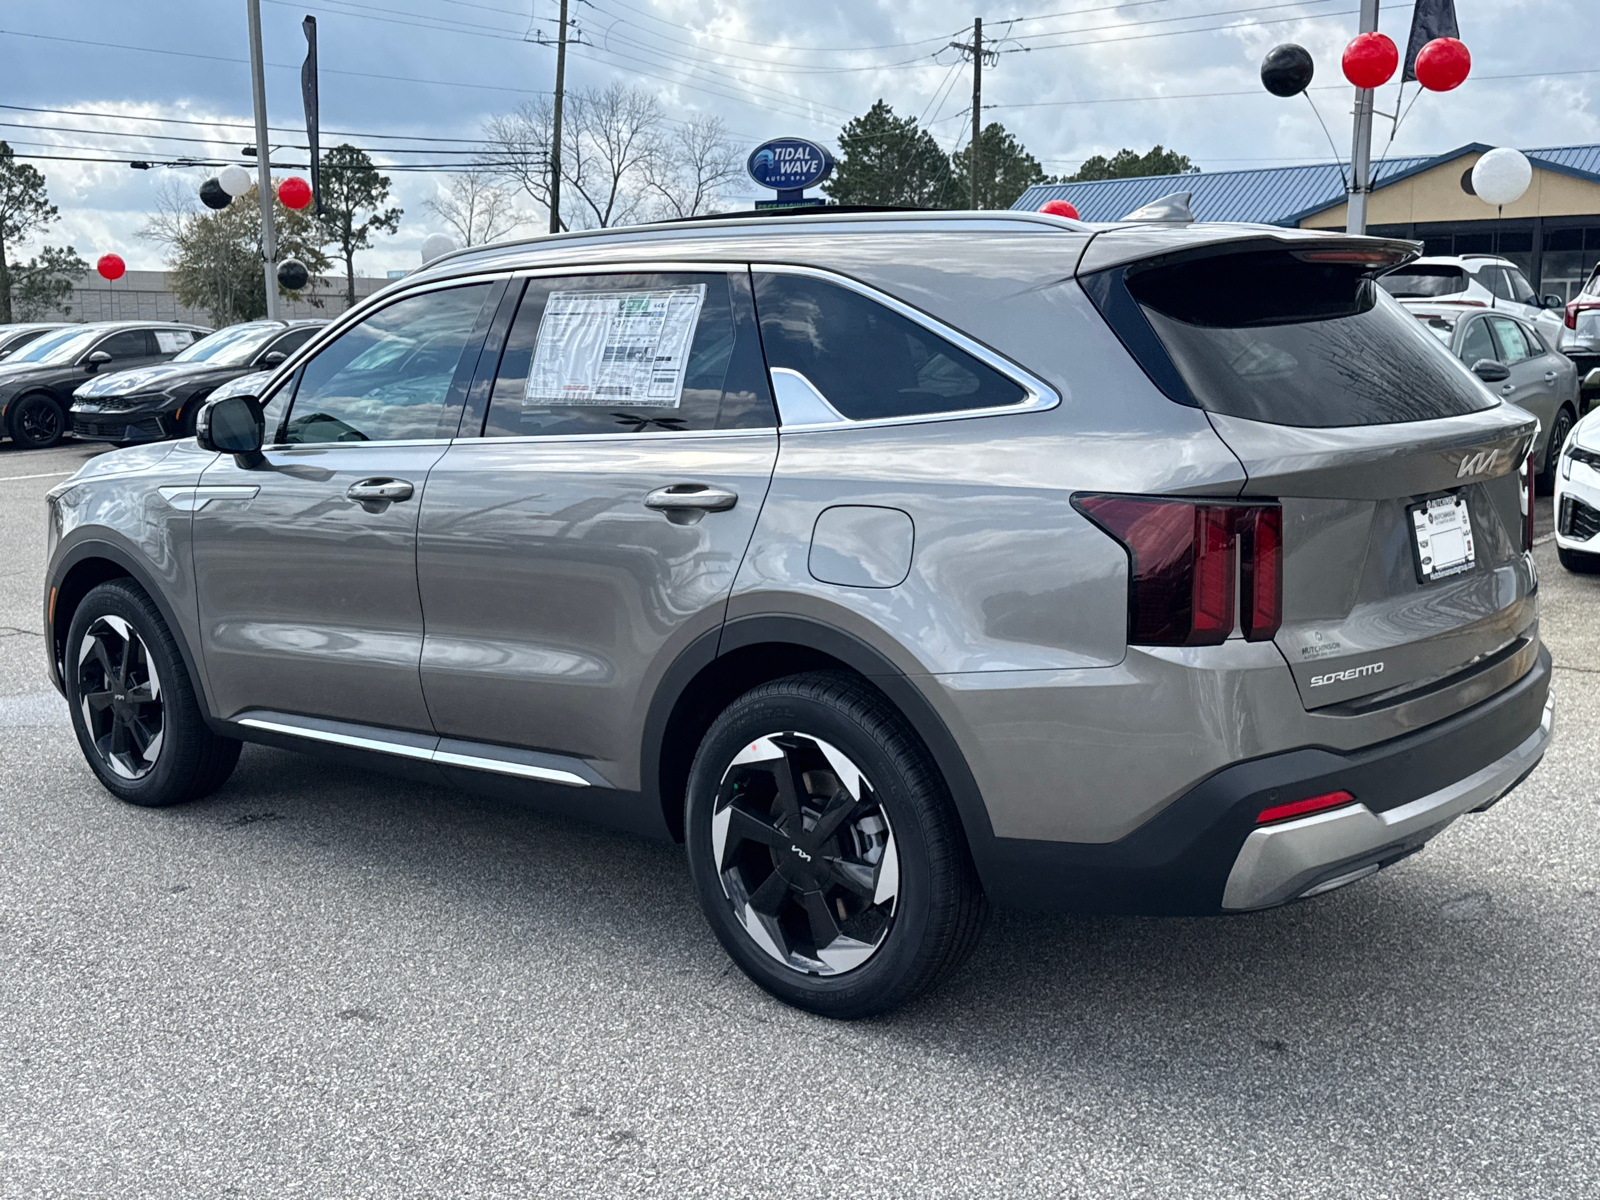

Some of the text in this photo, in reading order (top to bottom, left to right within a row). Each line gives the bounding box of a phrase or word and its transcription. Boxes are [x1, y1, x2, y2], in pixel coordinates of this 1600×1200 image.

[775, 147, 811, 160] TIDAL
[780, 160, 818, 174] WAVE
[1457, 449, 1499, 478] KIA
[1302, 642, 1341, 655] HUTCHINSON
[1310, 662, 1384, 687] SORENTO
